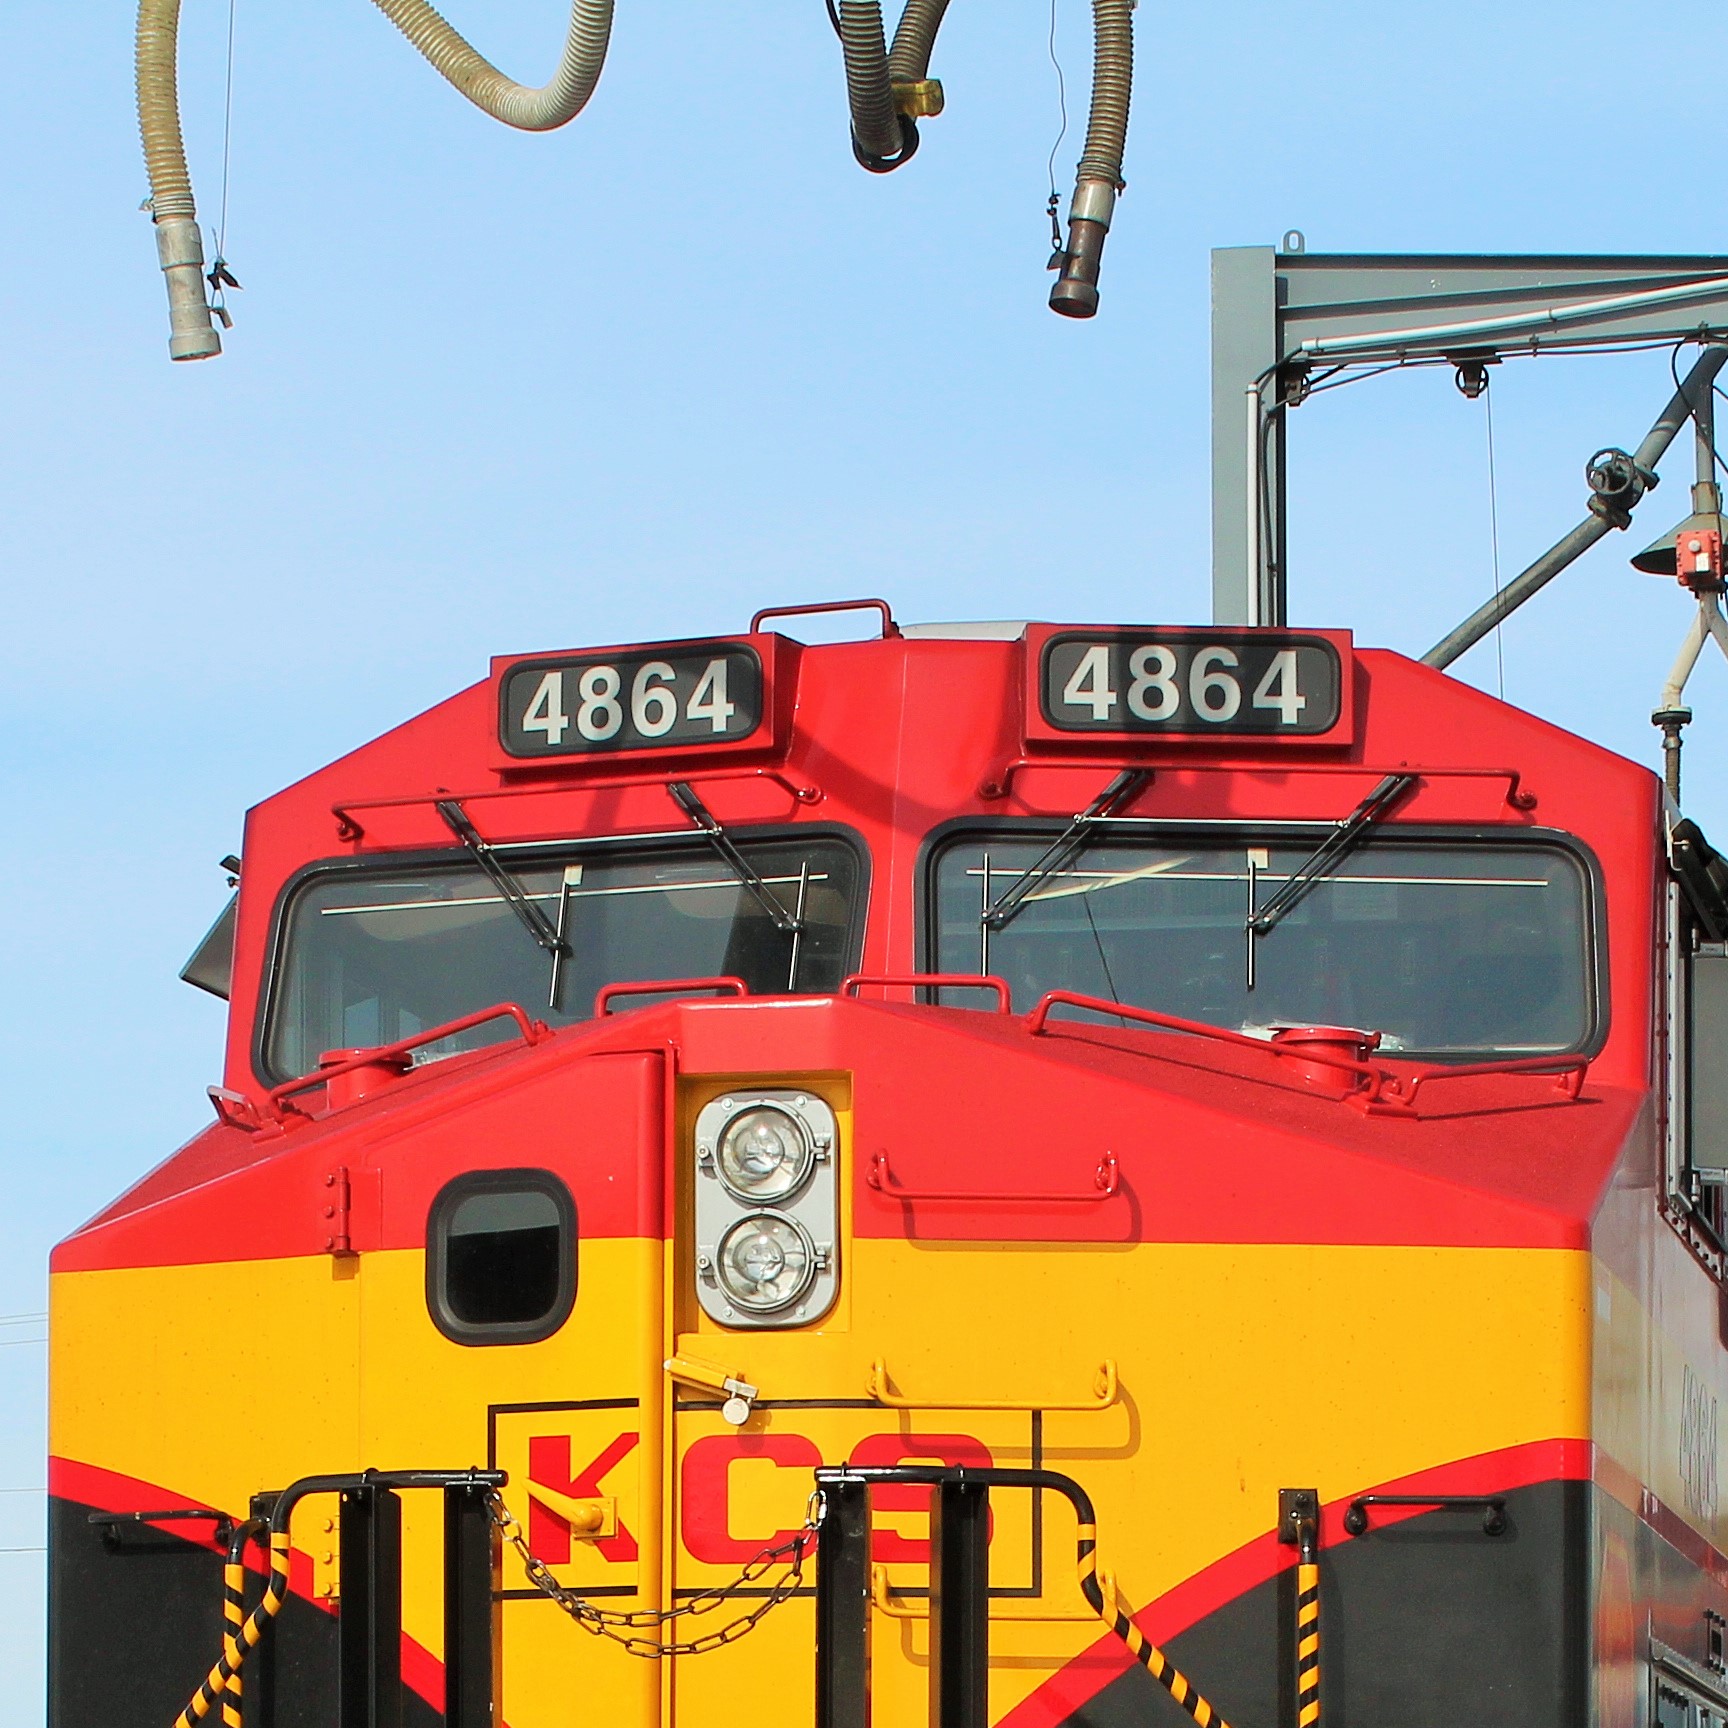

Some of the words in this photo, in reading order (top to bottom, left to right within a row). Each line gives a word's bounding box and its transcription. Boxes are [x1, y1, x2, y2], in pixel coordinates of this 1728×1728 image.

[523, 658, 735, 745] 4864
[1063, 645, 1306, 725] 4864
[529, 1432, 994, 1565] KCS
